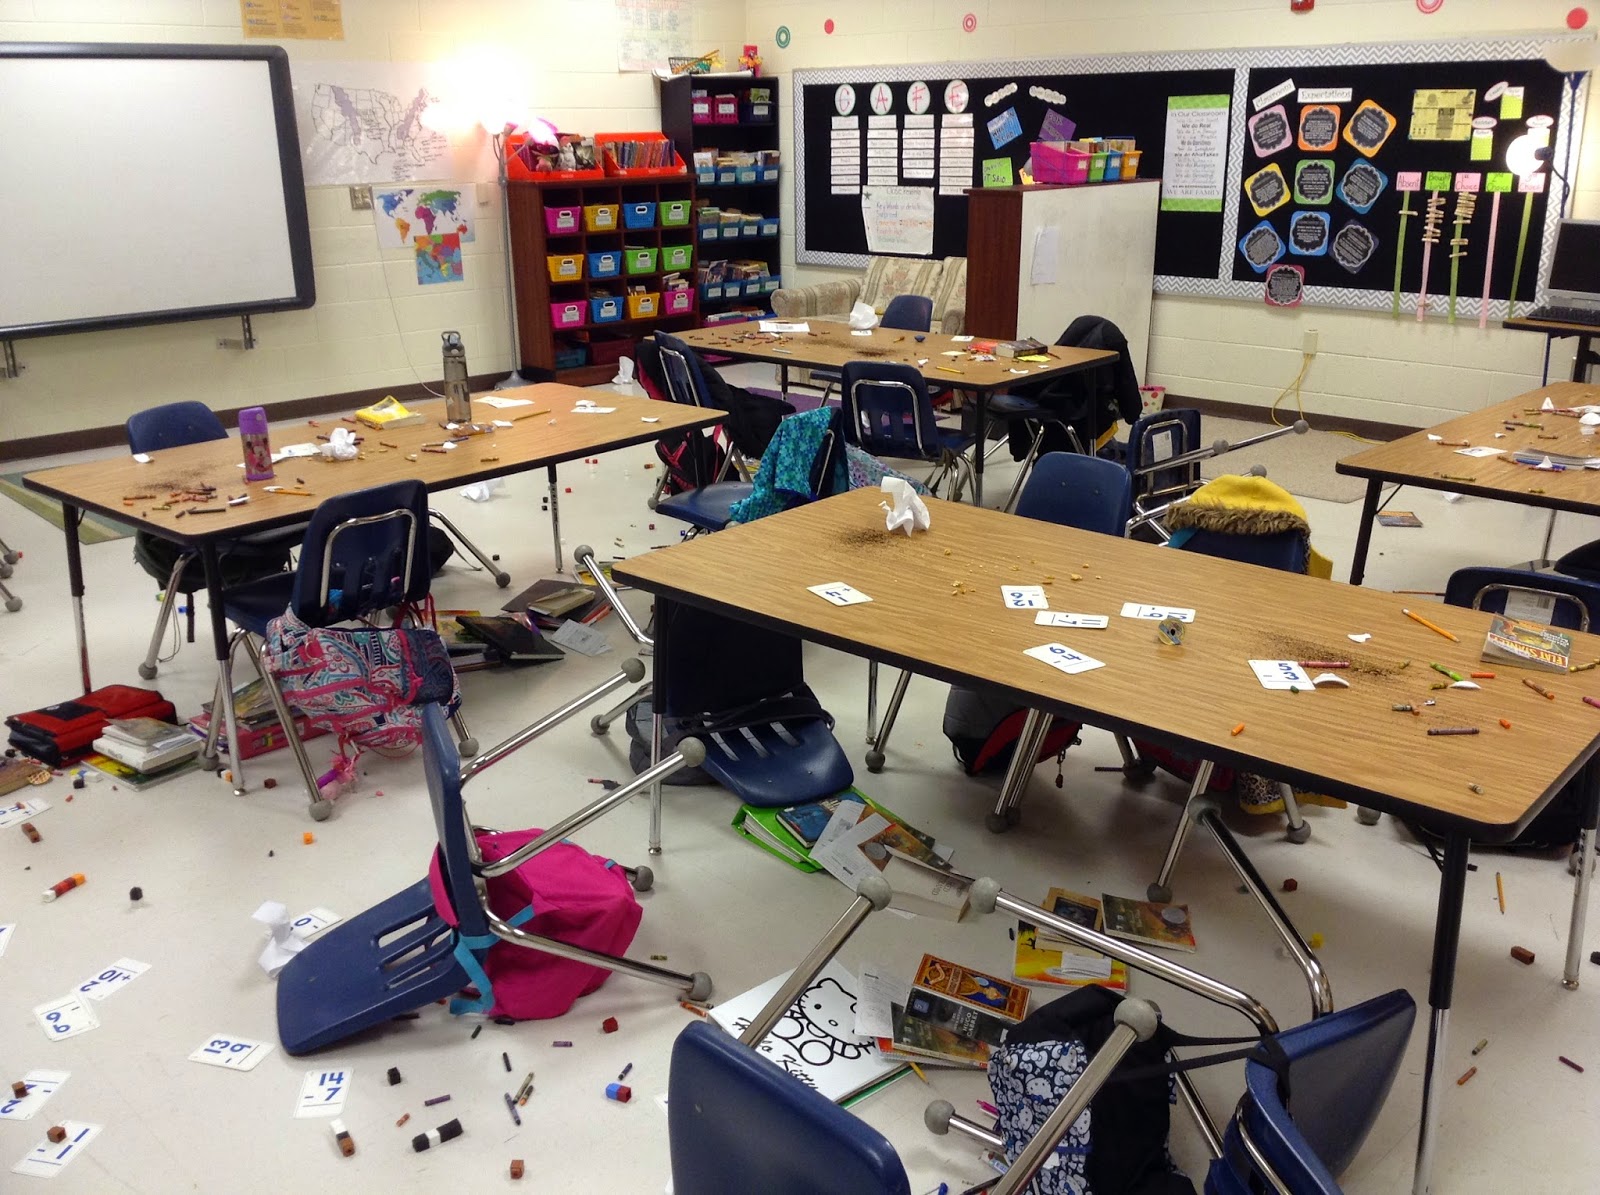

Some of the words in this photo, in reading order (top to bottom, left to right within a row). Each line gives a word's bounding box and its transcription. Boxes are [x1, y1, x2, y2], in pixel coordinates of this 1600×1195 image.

[1399, 175, 1420, 188] Absent
[1540, 652, 1563, 665] FLAT
[1278, 662, 1293, 671] 5
[1283, 672, 1299, 680] 3
[80, 980, 101, 992] 2
[962, 1012, 972, 1032] HUGO
[966, 1010, 979, 1037] CABRET
[204, 1040, 231, 1054] 13
[319, 1071, 344, 1086] 14
[324, 1087, 342, 1101] 7
[1, 1099, 22, 1114] 2
